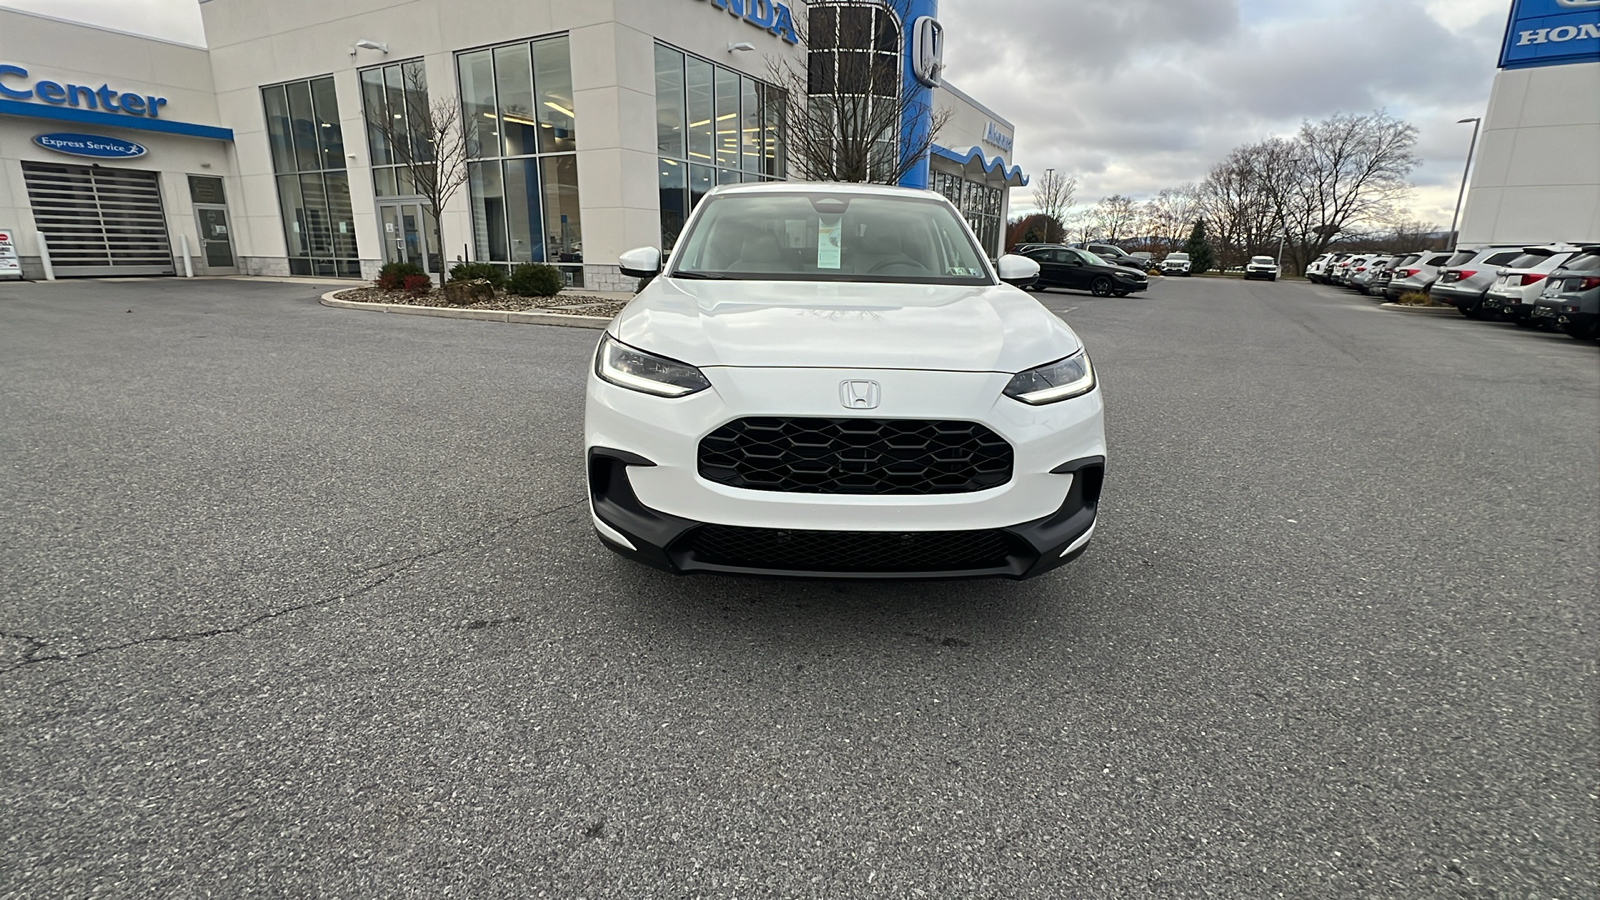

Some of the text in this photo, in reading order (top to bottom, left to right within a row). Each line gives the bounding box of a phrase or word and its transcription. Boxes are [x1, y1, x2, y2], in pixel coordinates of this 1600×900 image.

[0, 64, 168, 117] Center
[41, 136, 126, 152] Express Service
